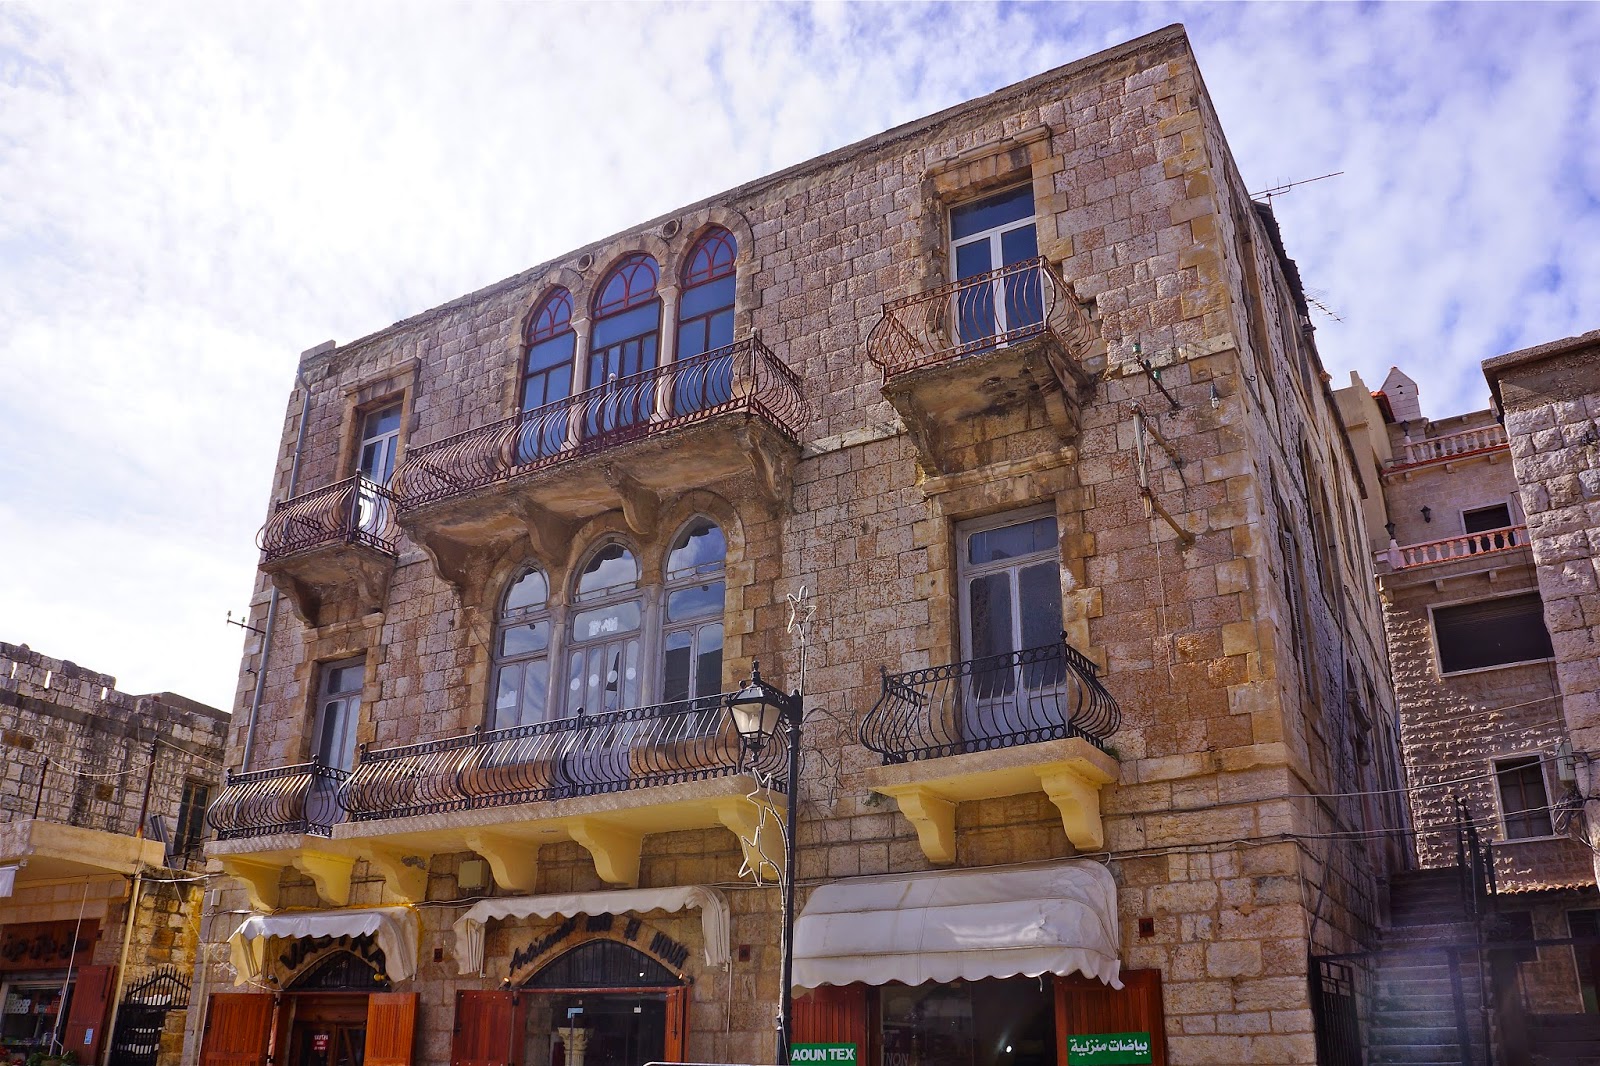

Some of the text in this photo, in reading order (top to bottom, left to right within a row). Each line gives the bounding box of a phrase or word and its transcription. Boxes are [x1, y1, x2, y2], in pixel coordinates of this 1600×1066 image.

[650, 931, 690, 969] NOUR
[791, 1047, 855, 1061] AOUN TEX
[1069, 1038, 1148, 1057] بياضات منزلية
